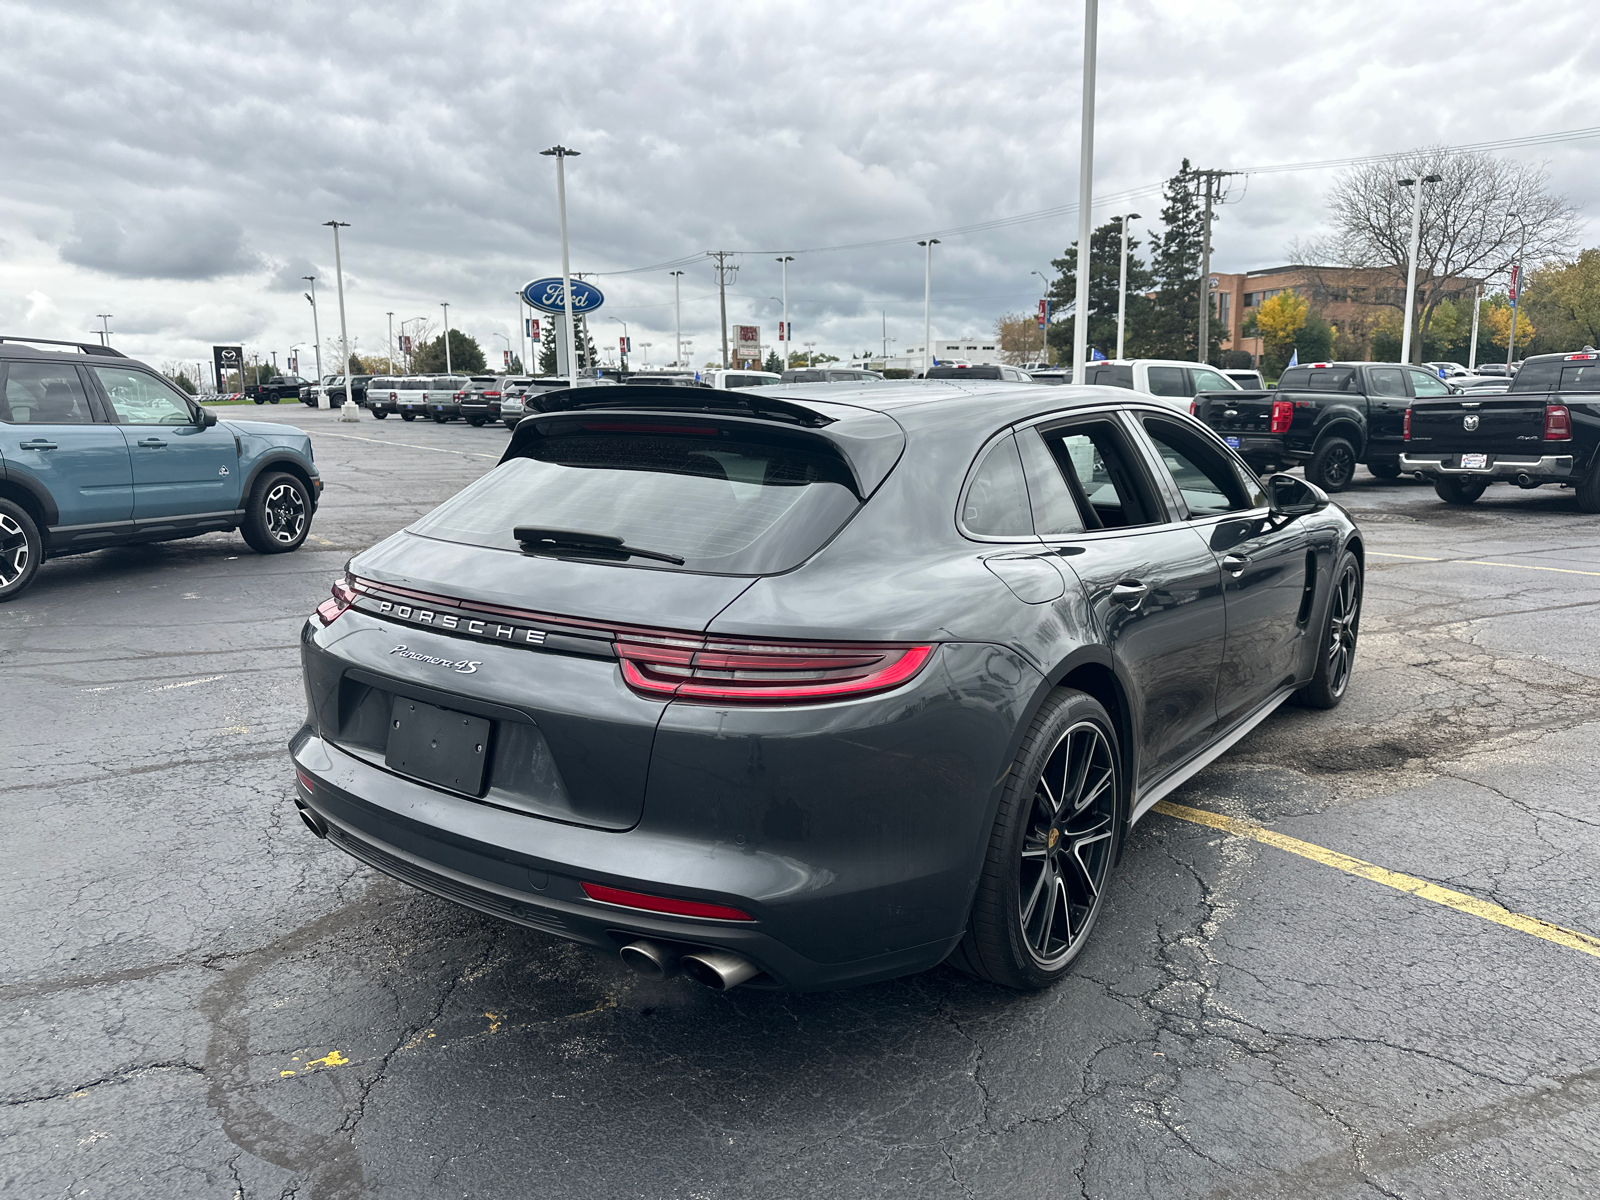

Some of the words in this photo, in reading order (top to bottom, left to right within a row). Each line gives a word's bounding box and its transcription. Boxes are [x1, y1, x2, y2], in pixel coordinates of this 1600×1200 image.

[379, 601, 547, 644] PORSCHE
[389, 644, 453, 668] Panamera
[454, 659, 483, 674] 4S
[1028, 722, 1062, 789] Continental
